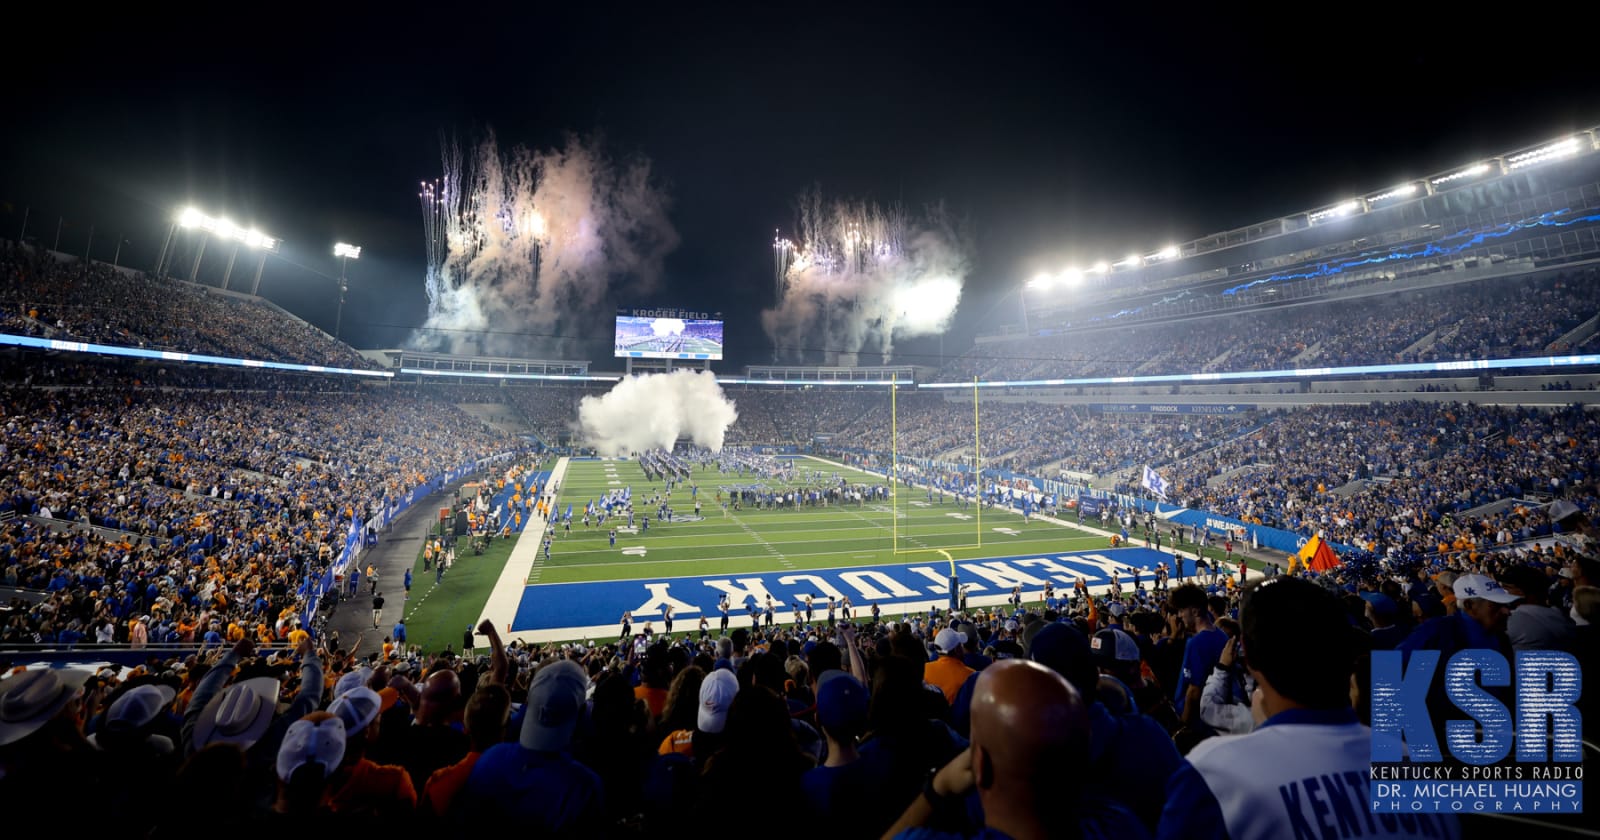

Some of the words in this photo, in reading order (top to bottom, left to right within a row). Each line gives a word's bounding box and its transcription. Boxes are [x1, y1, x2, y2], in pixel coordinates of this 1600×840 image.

[633, 309, 675, 318] KROGER
[679, 311, 708, 319] FIELD
[630, 554, 1156, 616] KENTUCKY
